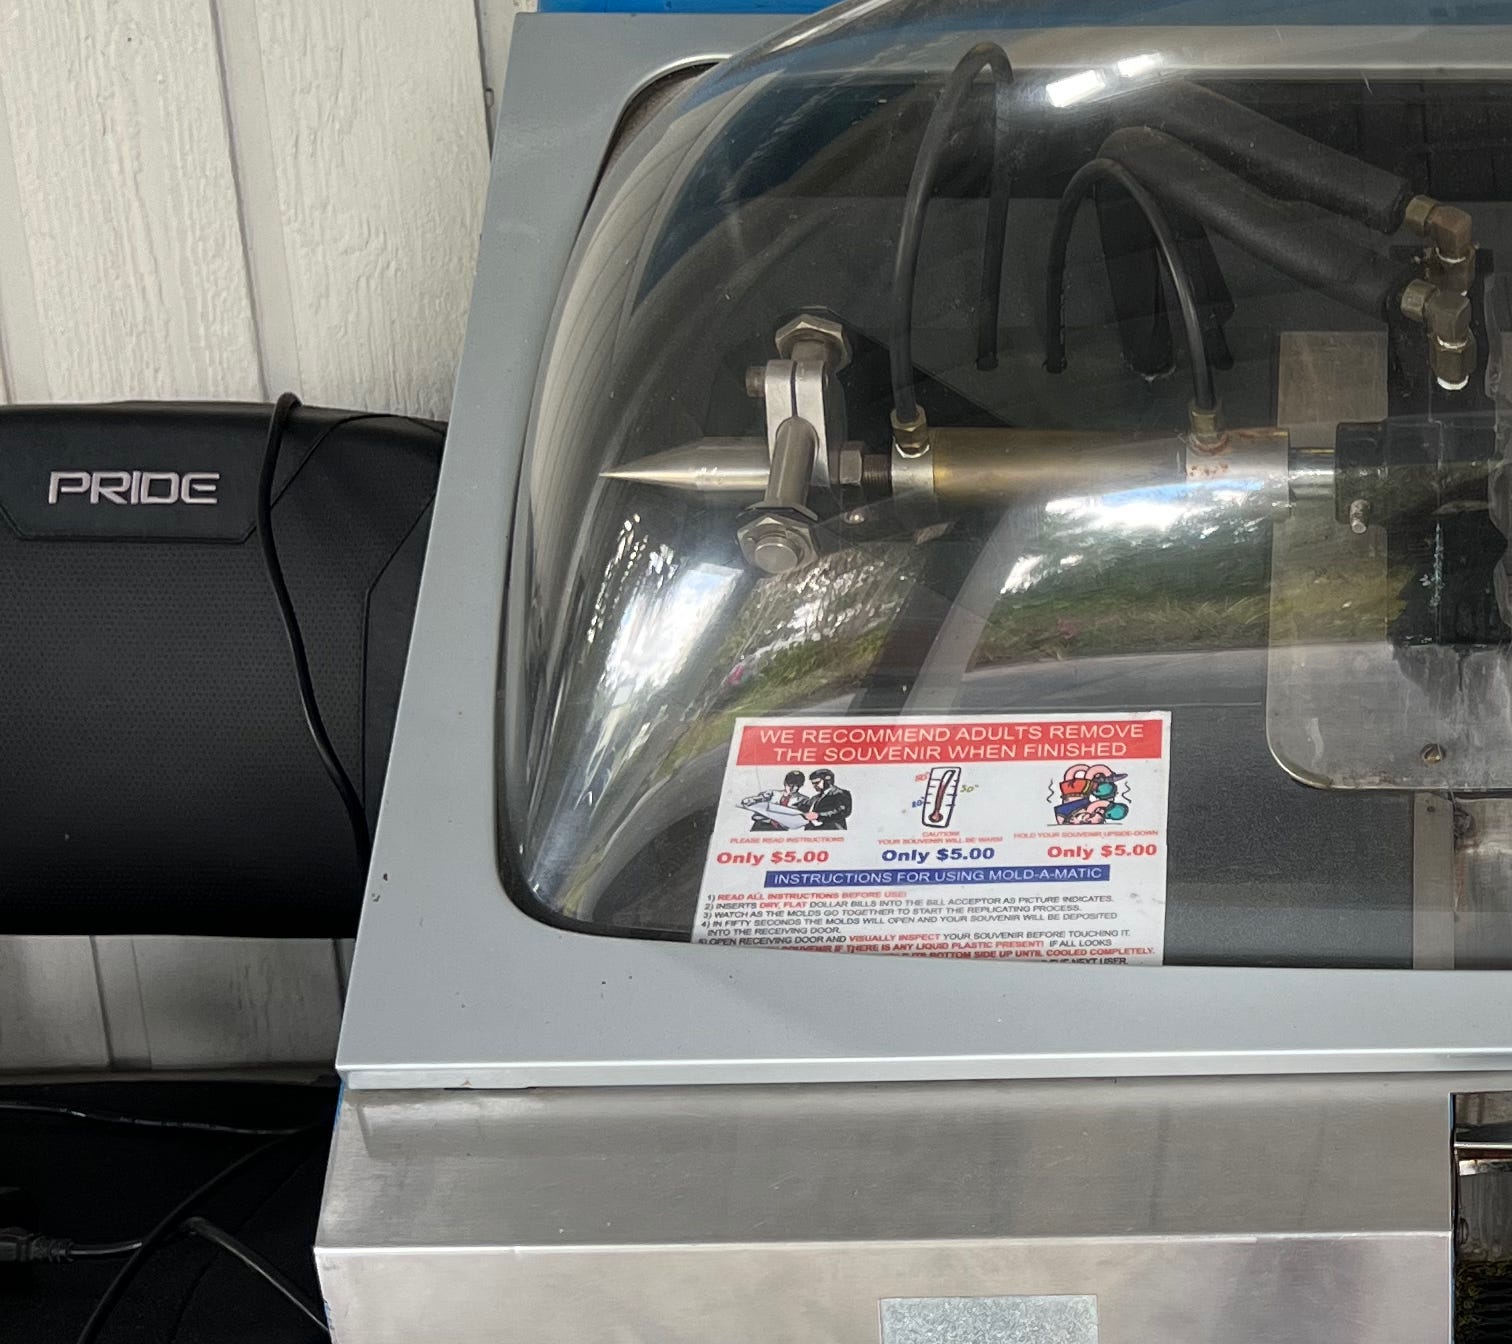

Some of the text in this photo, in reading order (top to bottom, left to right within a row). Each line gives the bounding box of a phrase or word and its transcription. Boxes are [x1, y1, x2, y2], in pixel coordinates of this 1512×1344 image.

[48, 470, 220, 505] PRIDE
[760, 724, 1144, 744] WE RECOMMEND ADULTS REMOVE
[773, 742, 1127, 761] THE SOUVENIR WHEN FINISHED
[717, 850, 829, 865] Only $5.00
[882, 847, 995, 864] Only $5.00
[1047, 844, 1157, 860] Only $5.00
[773, 867, 1102, 885] INSTRUCTIONS FOR USING MOLD-A-MATIC
[715, 902, 757, 910] INSERTS
[1062, 895, 1114, 903] INDICATES.
[767, 892, 839, 900] INSTRUCTIONS
[842, 891, 881, 899] BEFORE
[842, 908, 894, 916] TOGETHER
[967, 905, 1030, 913] REPLICATING
[970, 914, 1020, 922] SOUVENIR
[1063, 912, 1118, 920] DEPOSITED
[739, 936, 792, 944] RECEIVING
[825, 935, 847, 943] AND
[849, 934, 896, 942] VISUALLY
[898, 933, 940, 941] INSPECT
[973, 931, 1024, 940] SOUVENIR
[1068, 930, 1118, 938] TOUCHING
[754, 927, 807, 935] RECEIVING
[810, 926, 840, 934] DOOR.
[847, 944, 878, 952] THERE
[881, 943, 890, 951] IS
[892, 943, 914, 951] ANY
[915, 942, 949, 950] LIQUID
[951, 941, 993, 949] PLASTIC
[1059, 939, 1076, 947] ALL
[1079, 938, 1112, 946] LOOKS
